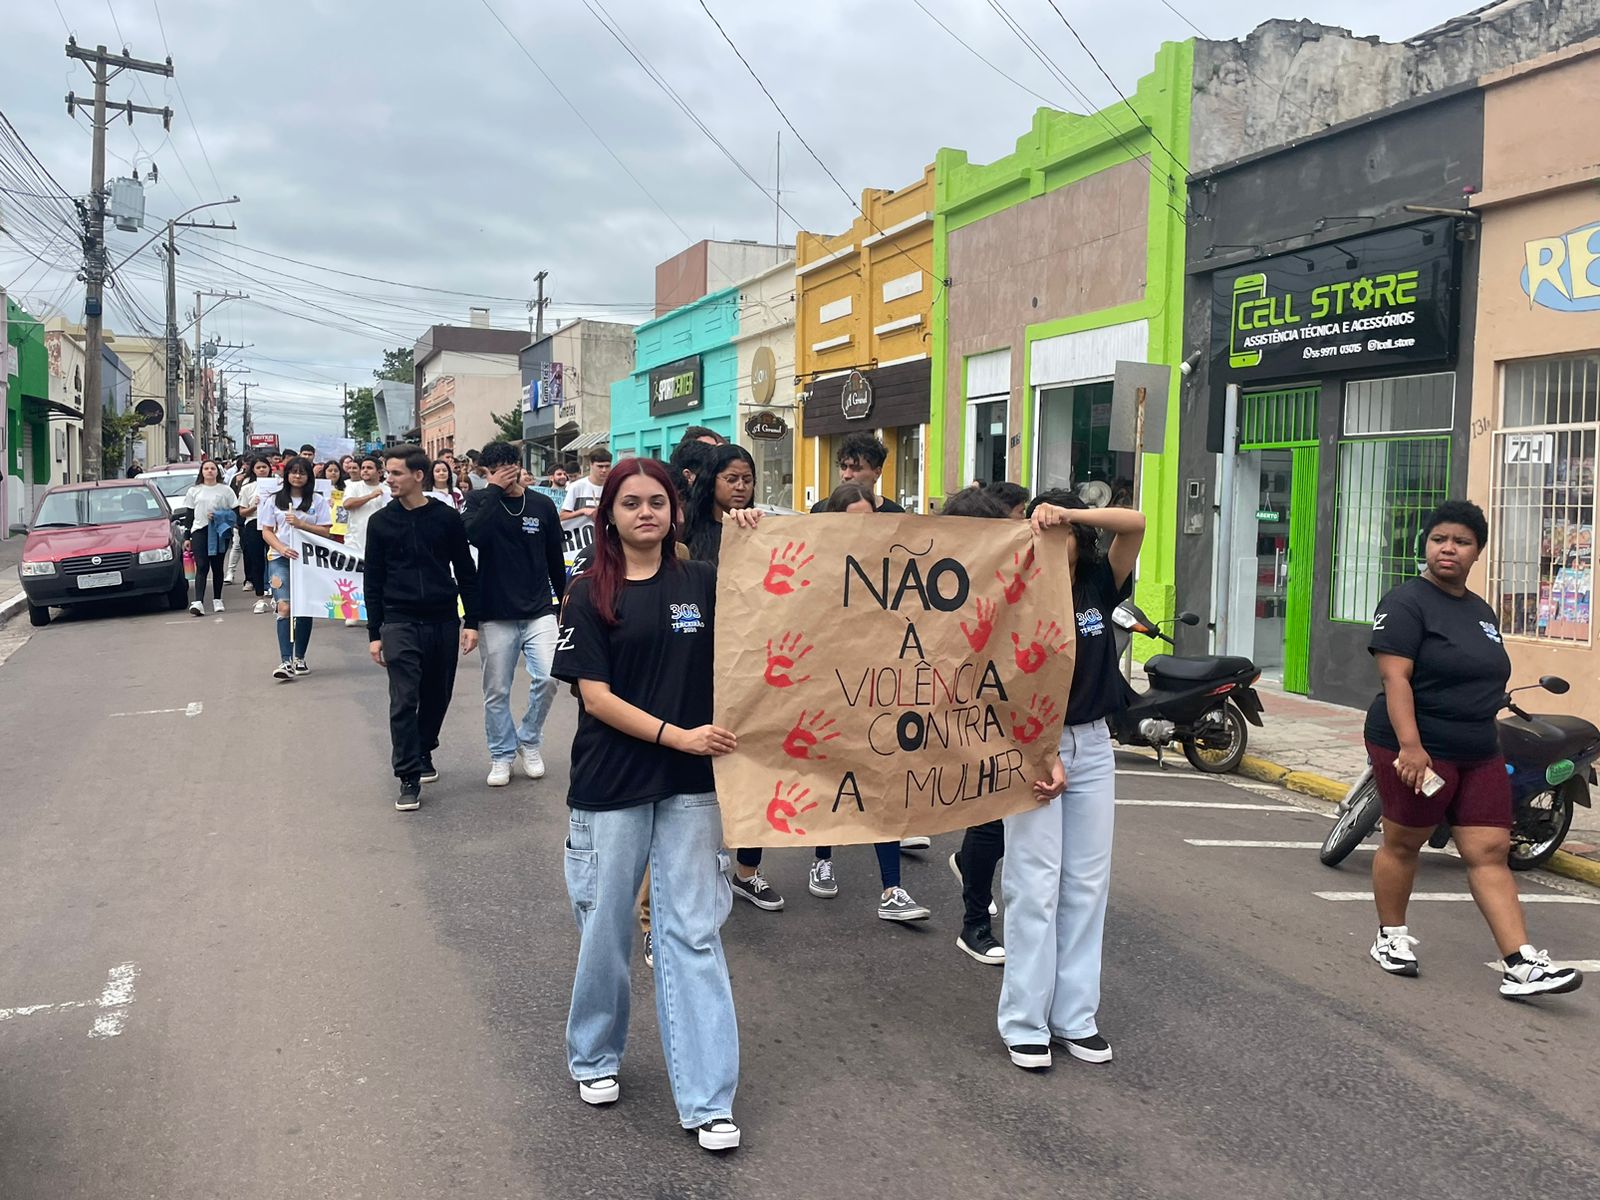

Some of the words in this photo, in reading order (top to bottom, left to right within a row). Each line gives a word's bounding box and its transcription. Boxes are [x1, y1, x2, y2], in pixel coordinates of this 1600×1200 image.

[1238, 294, 1302, 331] CELL
[1310, 270, 1419, 319] STORE
[1243, 329, 1299, 348] ASSISTÊNCIA
[1299, 323, 1340, 339] TÉCNICA
[1342, 321, 1350, 333] E
[1351, 311, 1415, 332] ACESSÓRIOS
[842, 538, 970, 612] NÃO
[669, 603, 701, 620] 303
[1076, 607, 1103, 627] 303
[899, 617, 925, 659] À
[835, 660, 1008, 708] VIOLÊNCIA
[868, 704, 1004, 756] CONTRA
[831, 771, 864, 812] A
[904, 749, 1026, 808] MULHER
